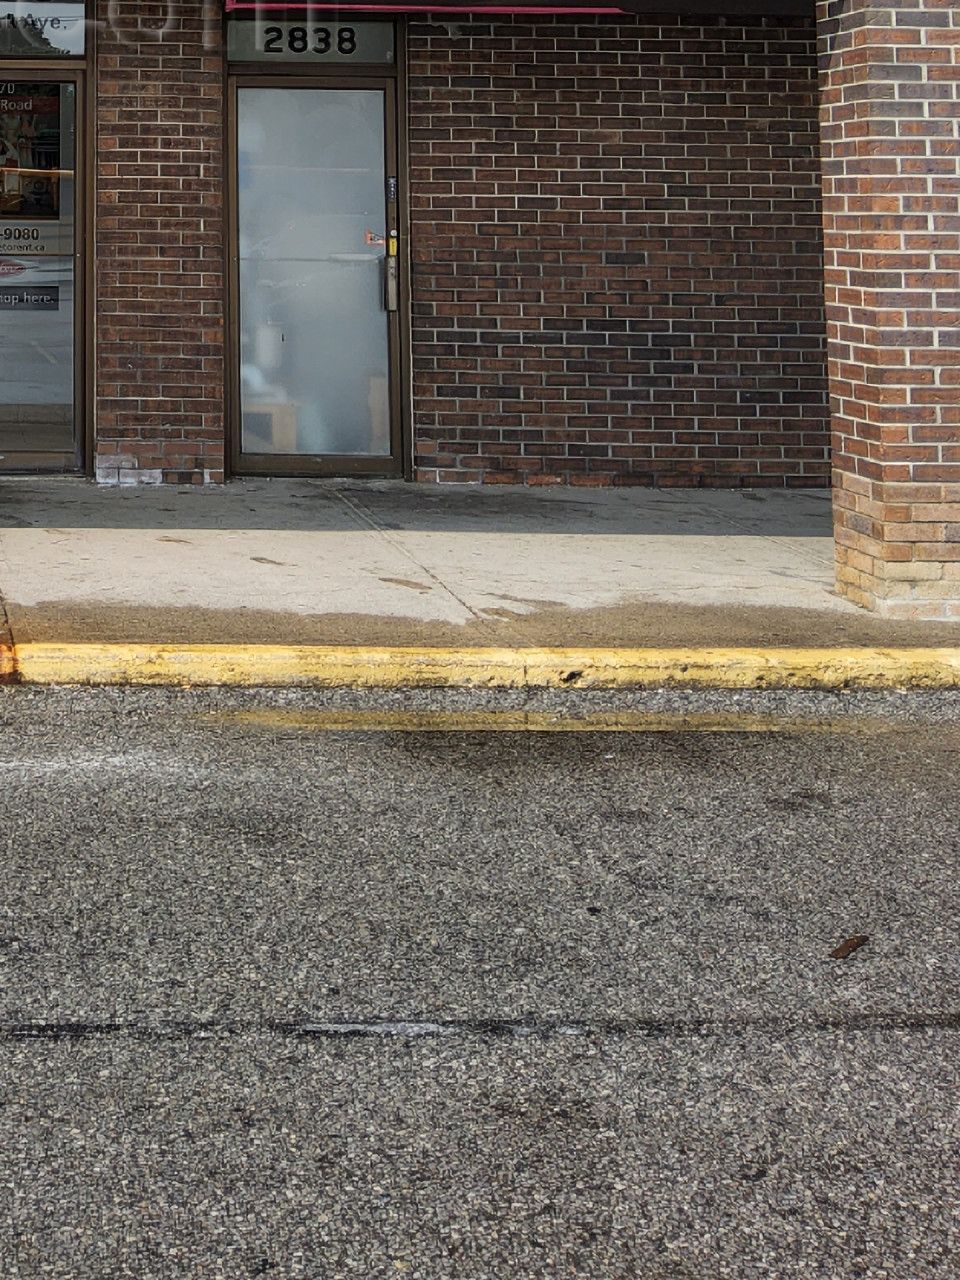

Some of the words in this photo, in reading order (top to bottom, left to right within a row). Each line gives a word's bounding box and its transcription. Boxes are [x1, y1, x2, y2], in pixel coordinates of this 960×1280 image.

[263, 26, 356, 54] 2838
[0, 82, 15, 94] 70
[0, 99, 33, 111] Road
[23, 292, 55, 304] here.
